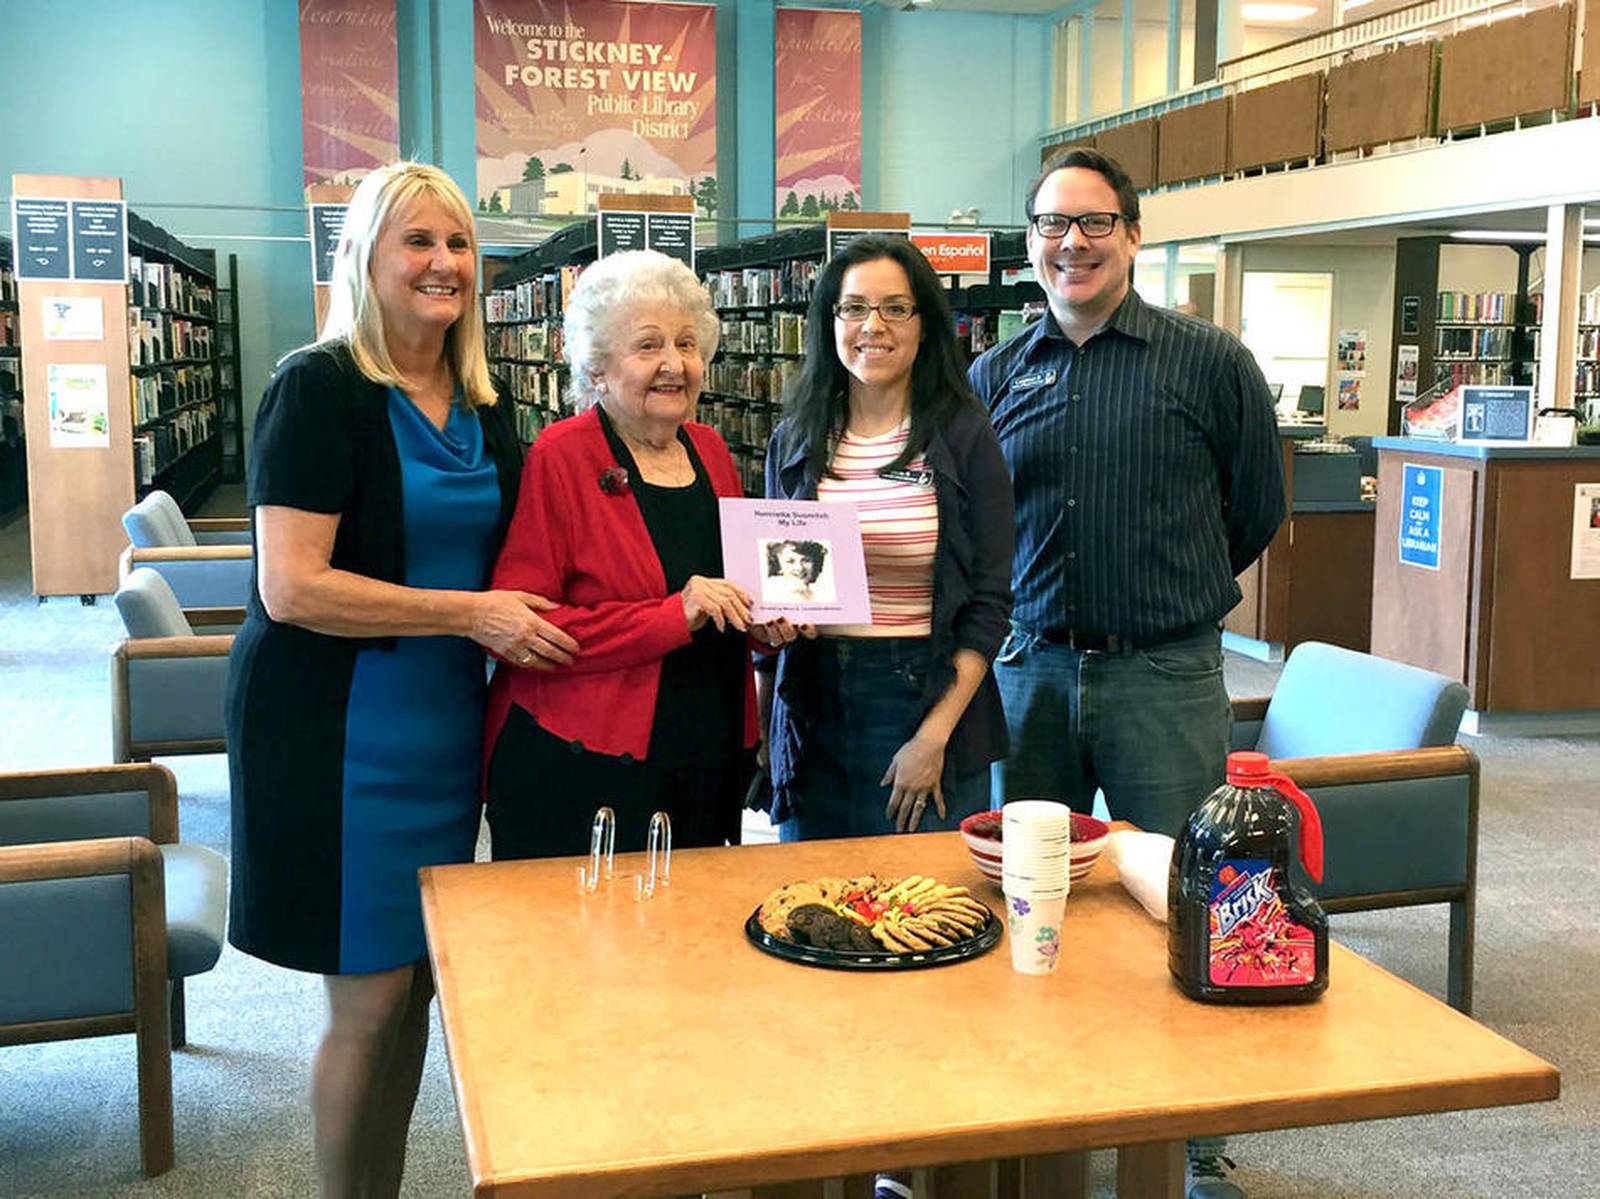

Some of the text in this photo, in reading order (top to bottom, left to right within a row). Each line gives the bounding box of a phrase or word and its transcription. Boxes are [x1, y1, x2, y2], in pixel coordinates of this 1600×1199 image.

[486, 15, 585, 39] Welcome to the
[527, 39, 672, 65] STICKNEY-
[504, 65, 697, 93] FOREST VIEW
[587, 93, 701, 119] Public Library
[632, 118, 690, 140] District
[921, 243, 984, 259] en Español
